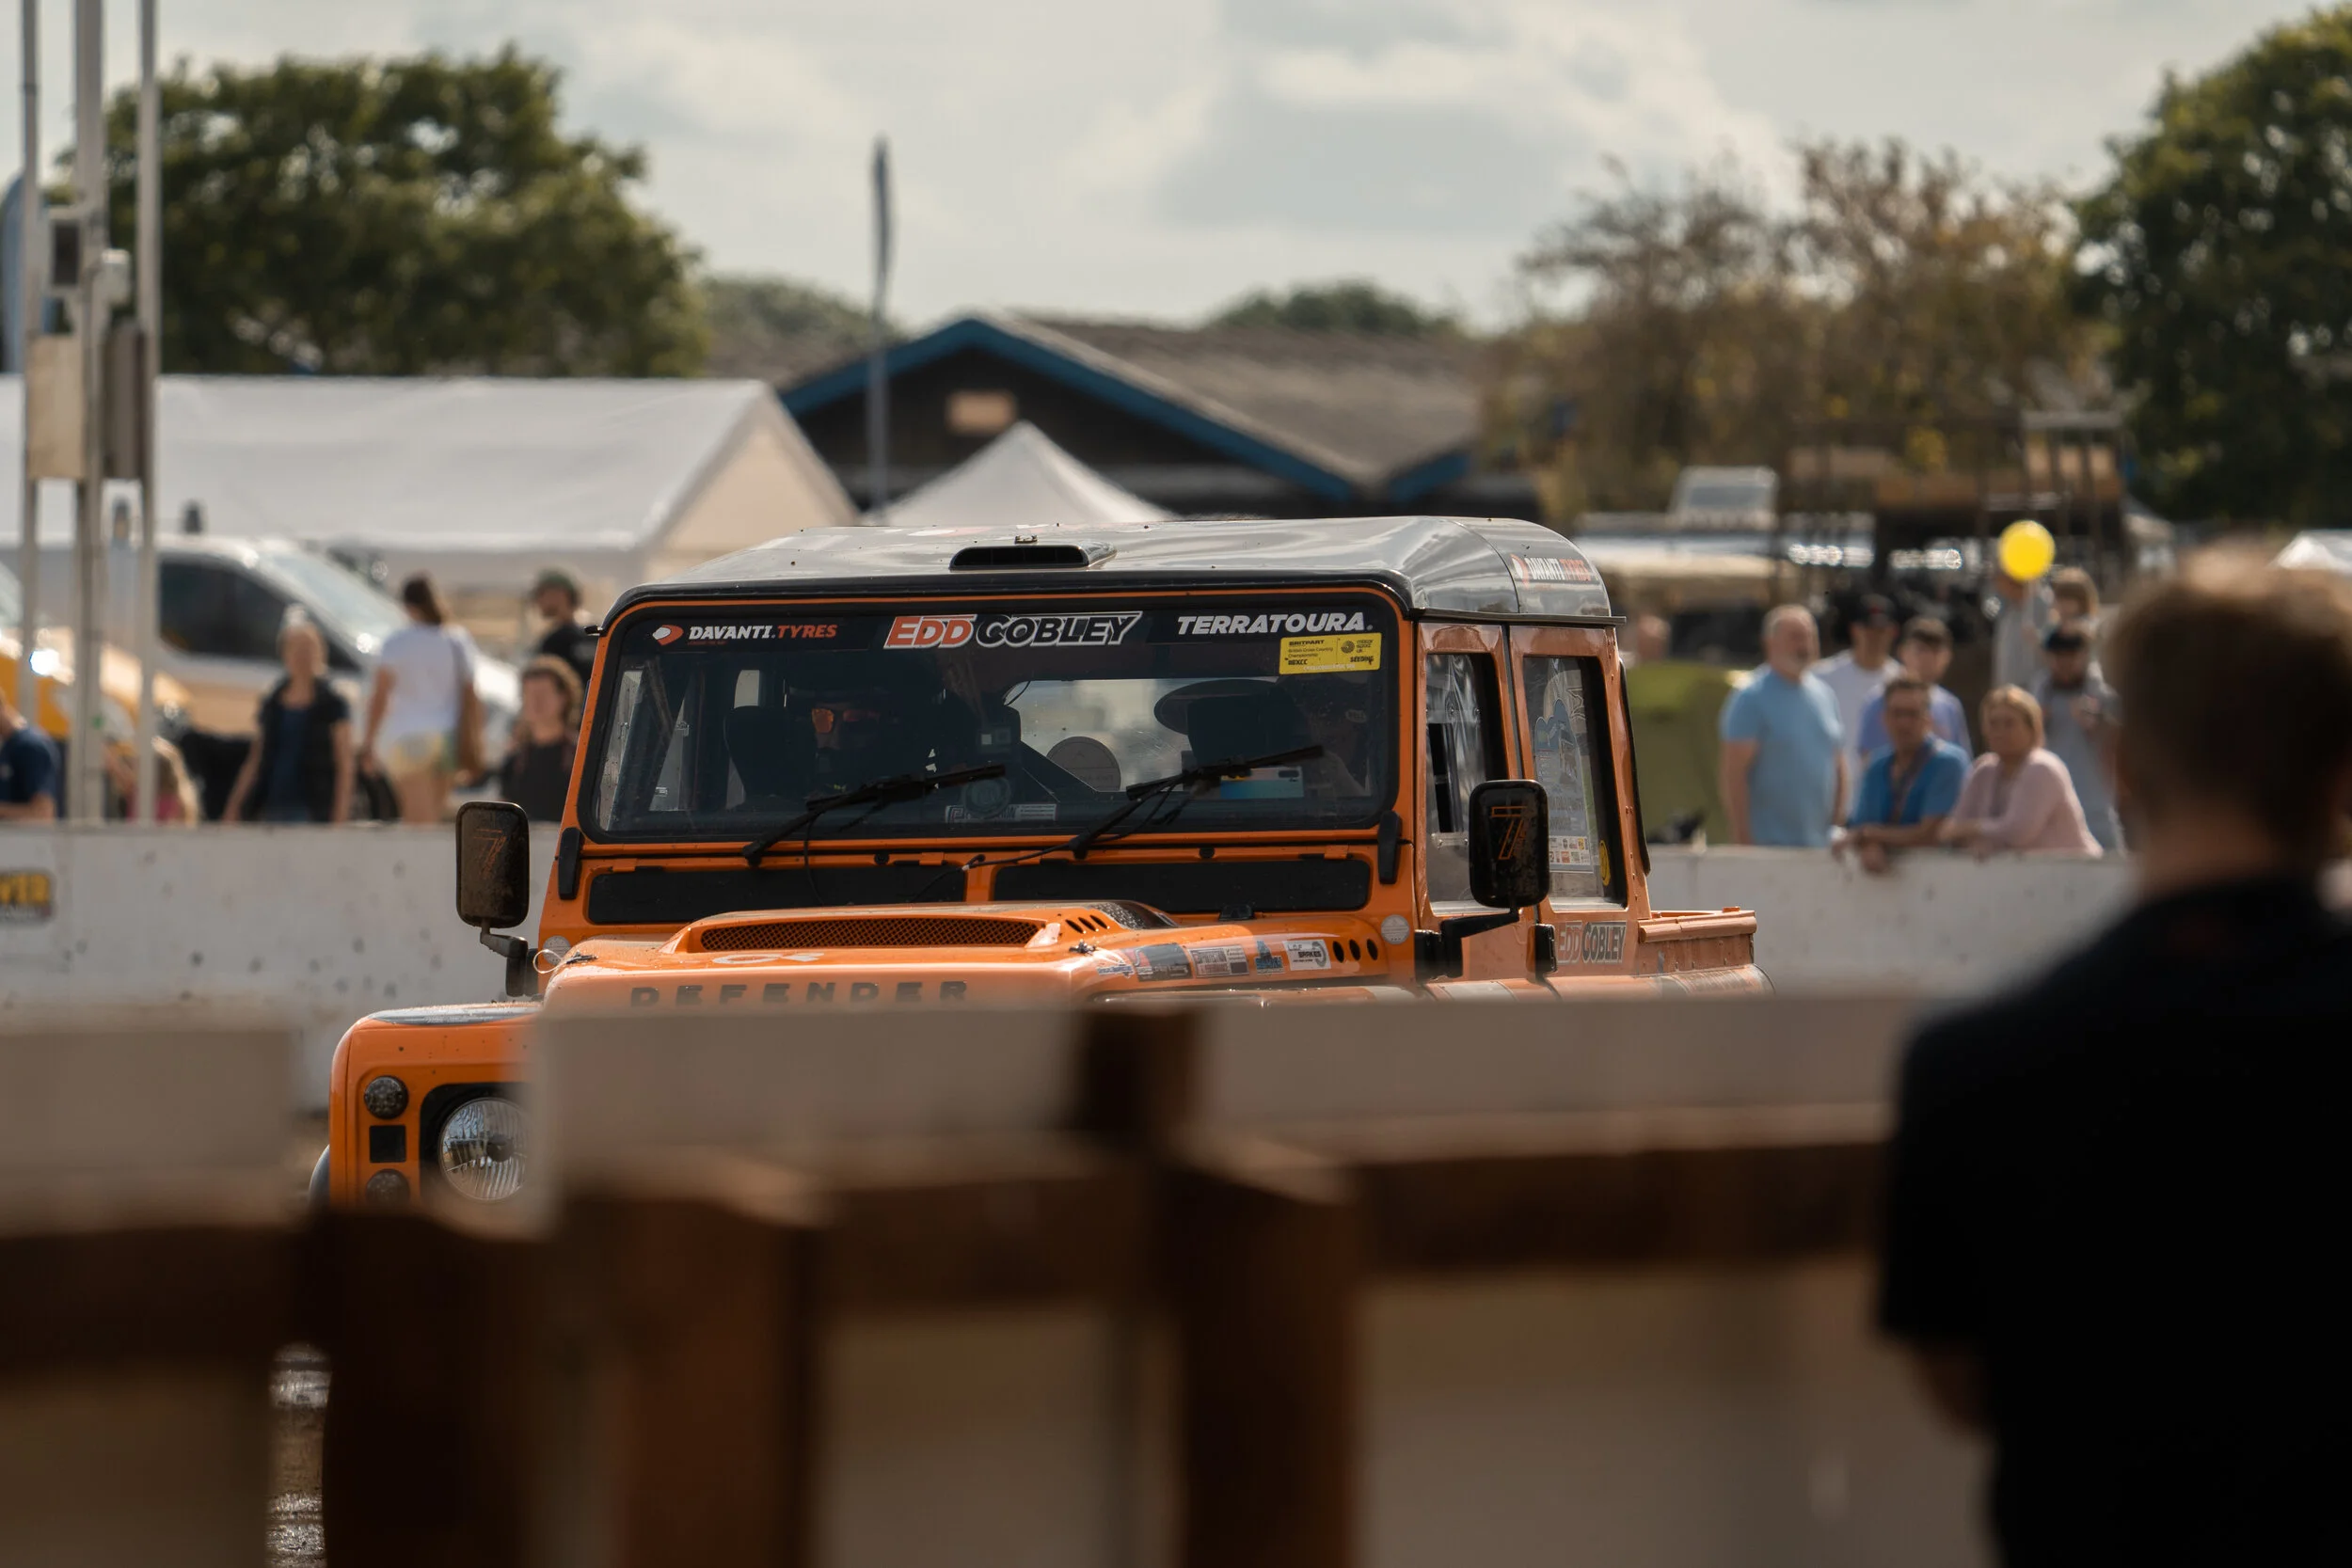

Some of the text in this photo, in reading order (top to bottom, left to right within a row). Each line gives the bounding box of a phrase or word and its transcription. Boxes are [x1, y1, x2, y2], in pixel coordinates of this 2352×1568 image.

[777, 624, 838, 639] TYRES
[883, 610, 1143, 649] EDD COBLEY
[1178, 611, 1365, 635] TERRATOURA
[1490, 805, 1526, 860] 7
[472, 829, 507, 879] 7
[1298, 950, 1322, 958] BRAKES
[1557, 920, 1628, 964] EDD COBLEY
[630, 980, 968, 1007] DEFENDER
